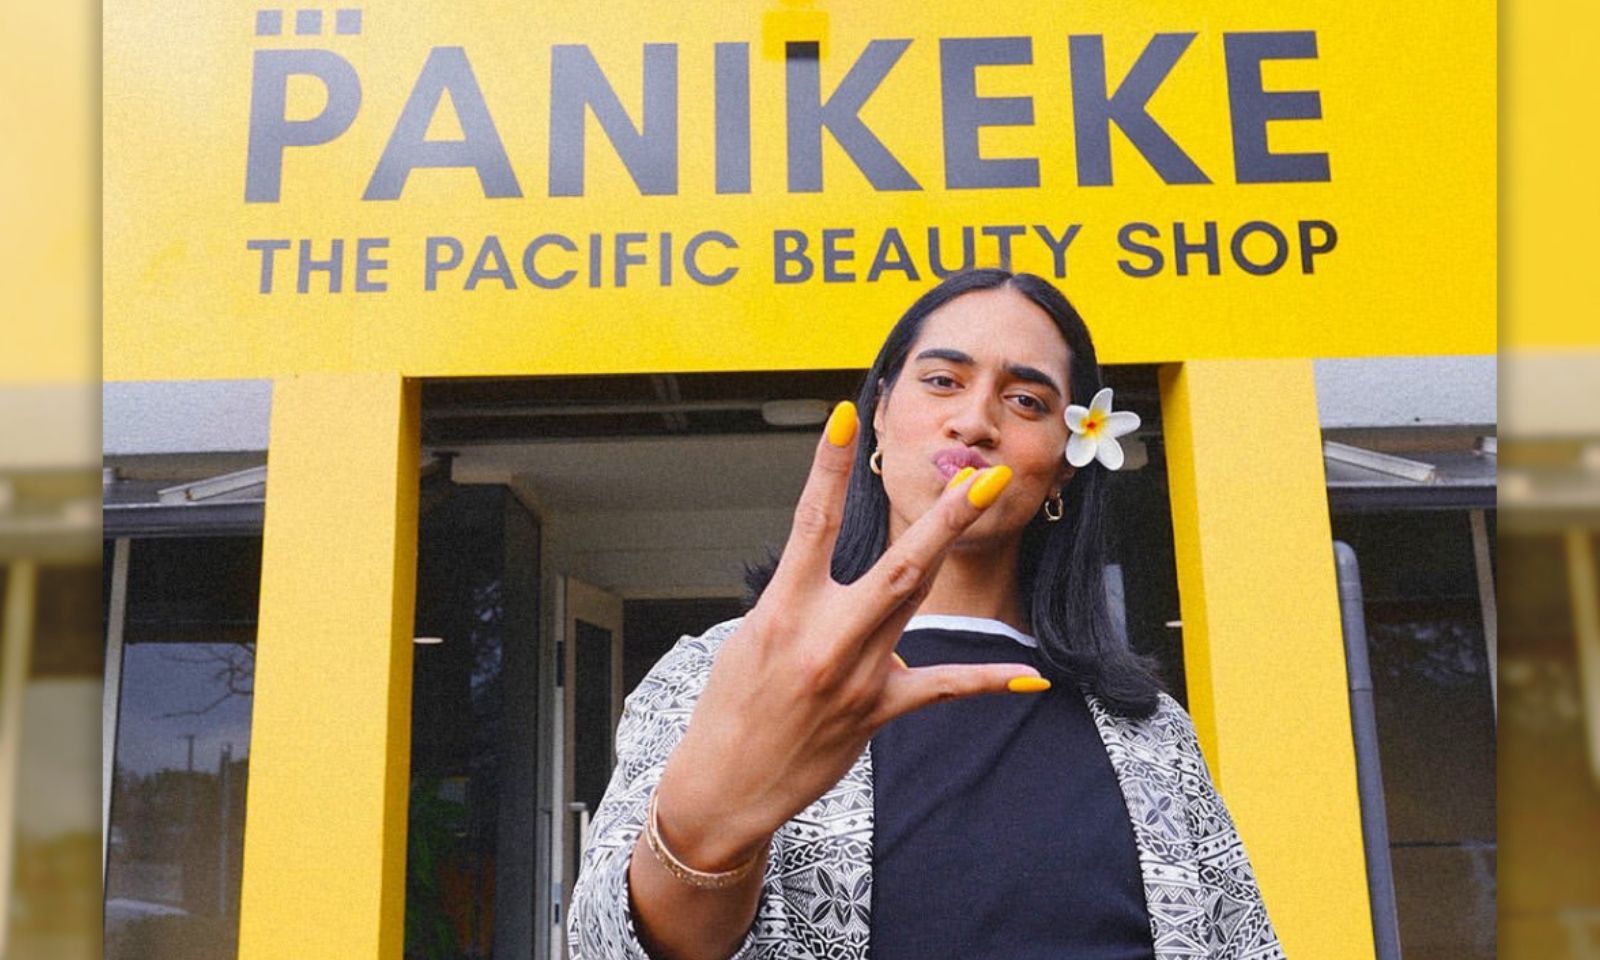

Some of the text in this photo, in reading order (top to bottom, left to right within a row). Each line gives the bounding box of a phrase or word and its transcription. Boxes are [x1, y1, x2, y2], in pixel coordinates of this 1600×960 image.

[244, 30, 1332, 204] PANIKEKE
[246, 220, 1338, 295] THE PACIFIC BEAUTY SHOP
